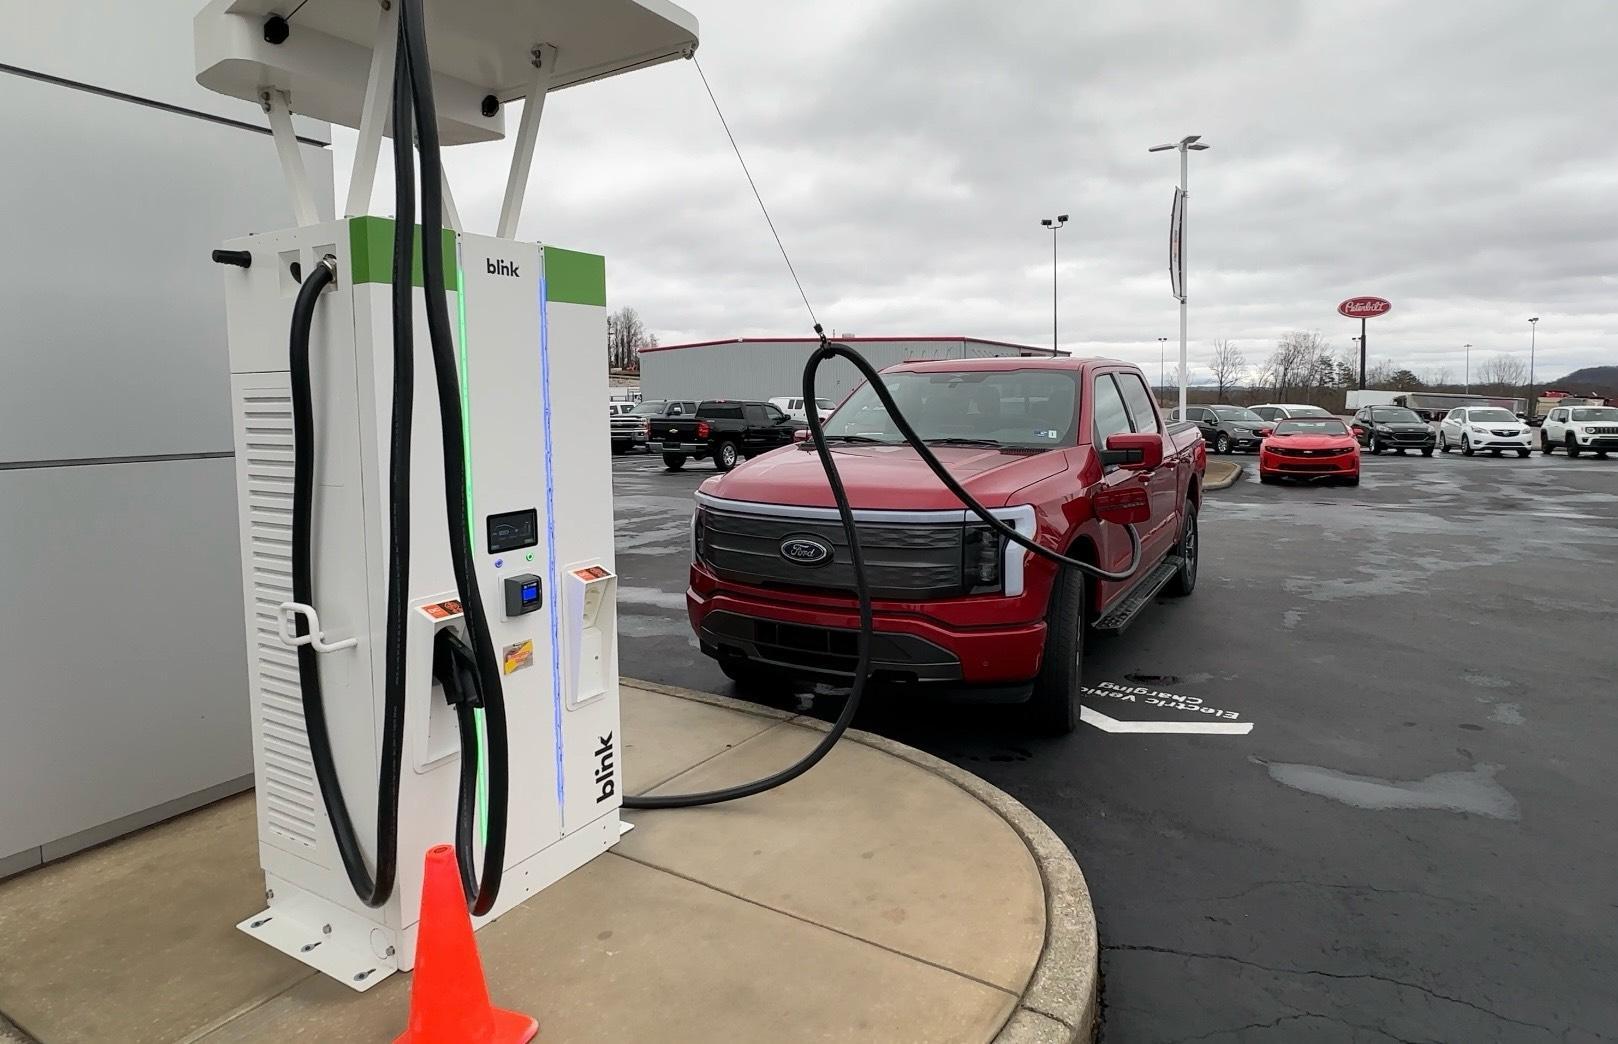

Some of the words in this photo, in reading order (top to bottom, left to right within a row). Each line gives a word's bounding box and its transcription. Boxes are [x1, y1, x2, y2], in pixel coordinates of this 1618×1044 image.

[487, 258, 520, 277] blink
[1345, 301, 1387, 313] Peterbilt
[790, 543, 815, 557] Ford
[1080, 686, 1136, 703] Vehic
[1097, 681, 1204, 705] Charging
[1145, 698, 1240, 720] Electric
[594, 730, 615, 804] blink
